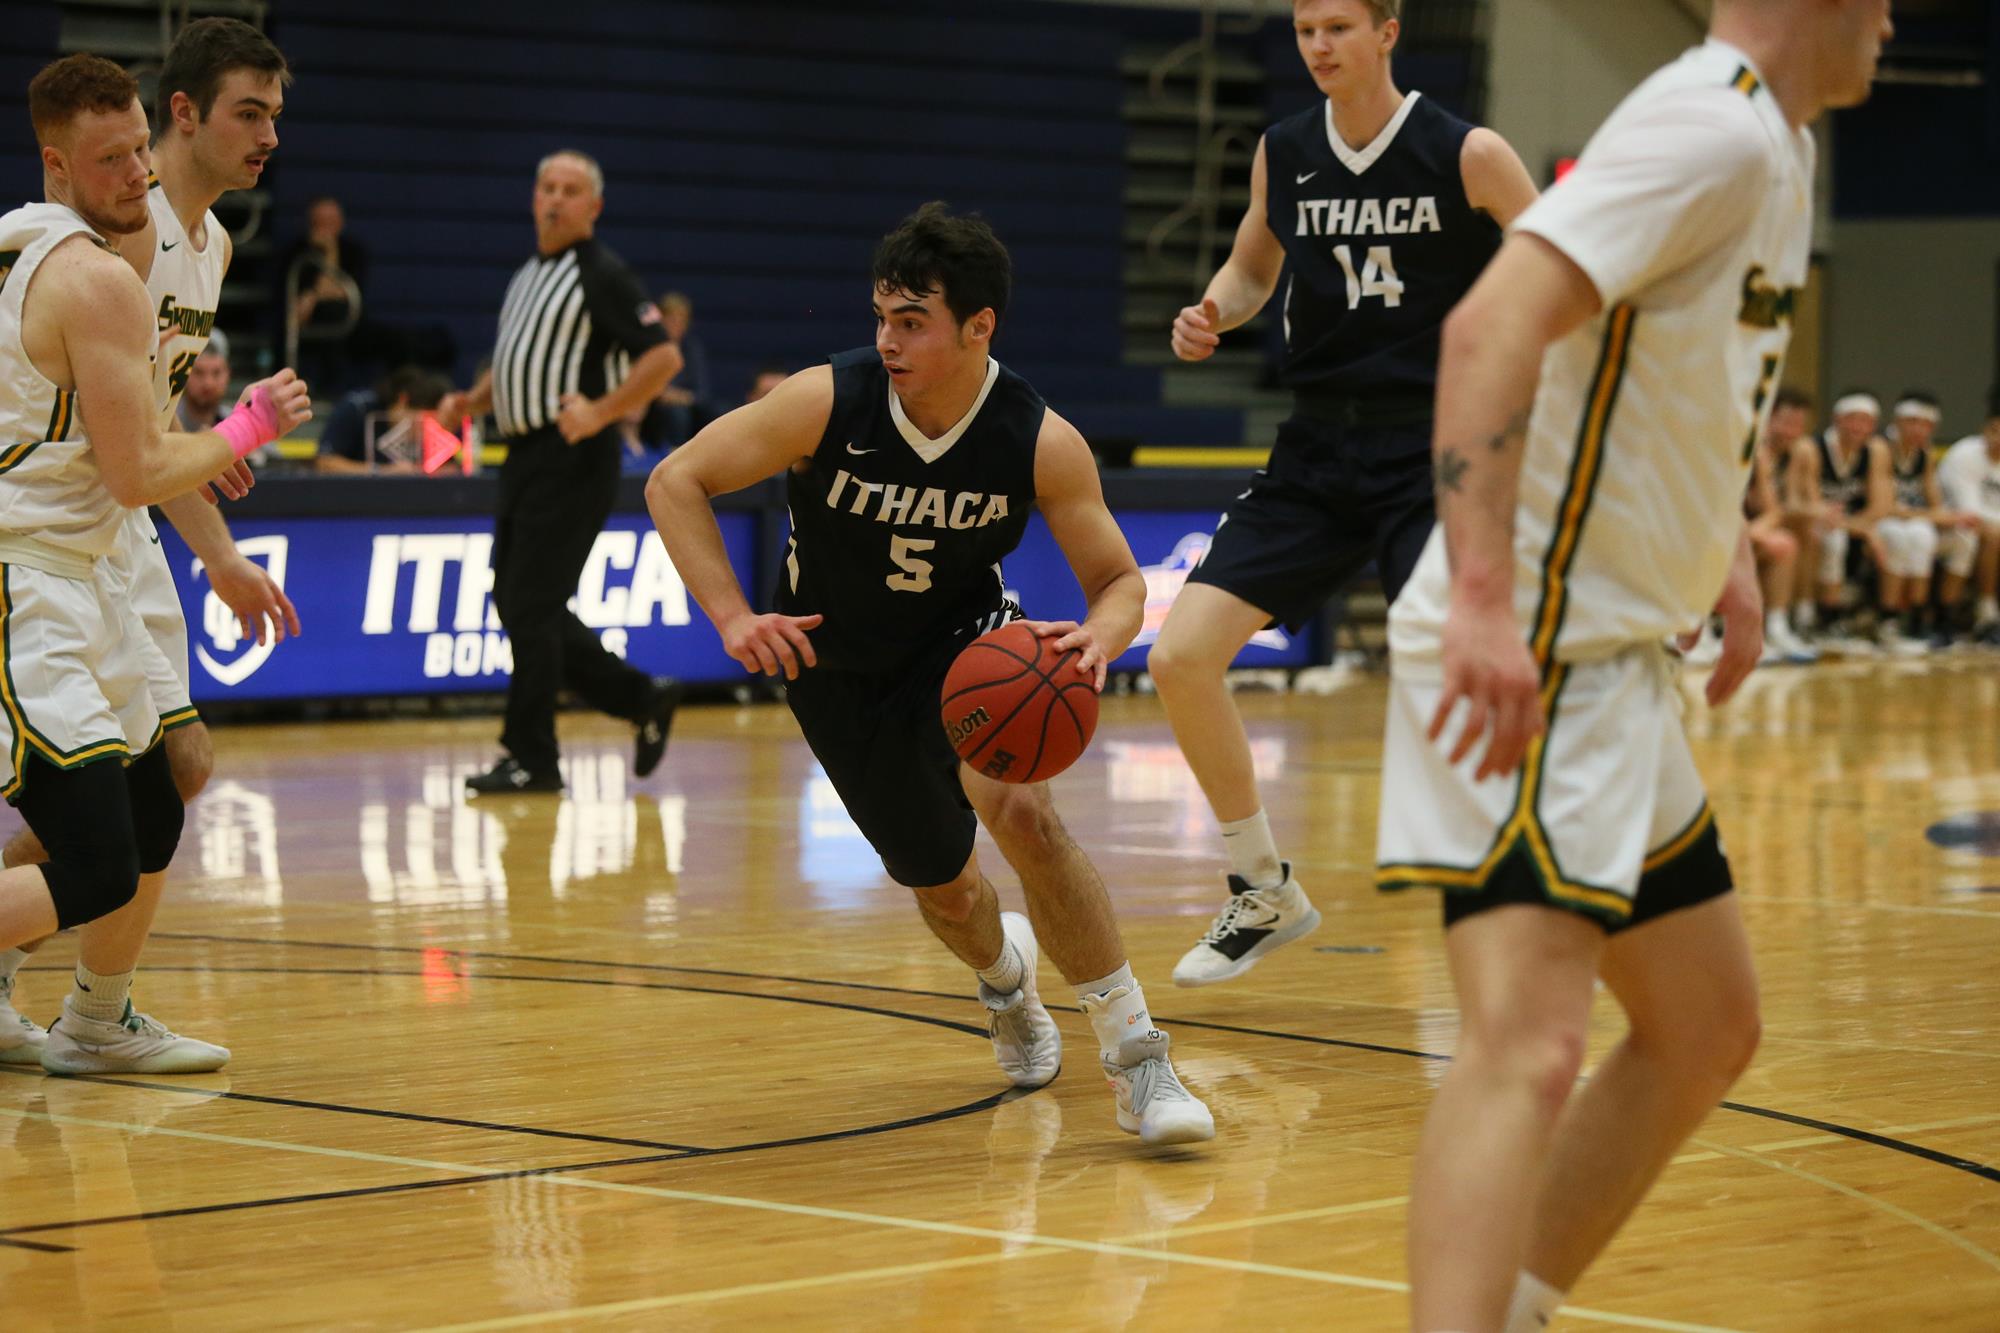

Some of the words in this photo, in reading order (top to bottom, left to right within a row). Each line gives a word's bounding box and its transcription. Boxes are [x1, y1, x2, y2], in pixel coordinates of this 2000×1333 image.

[1295, 196, 1441, 236] ITHACA
[1332, 244, 1405, 310] 14
[827, 469, 1008, 529] ITHACA
[362, 530, 690, 634] ITHCA
[886, 534, 935, 592] 5
[423, 628, 628, 678] BOMS
